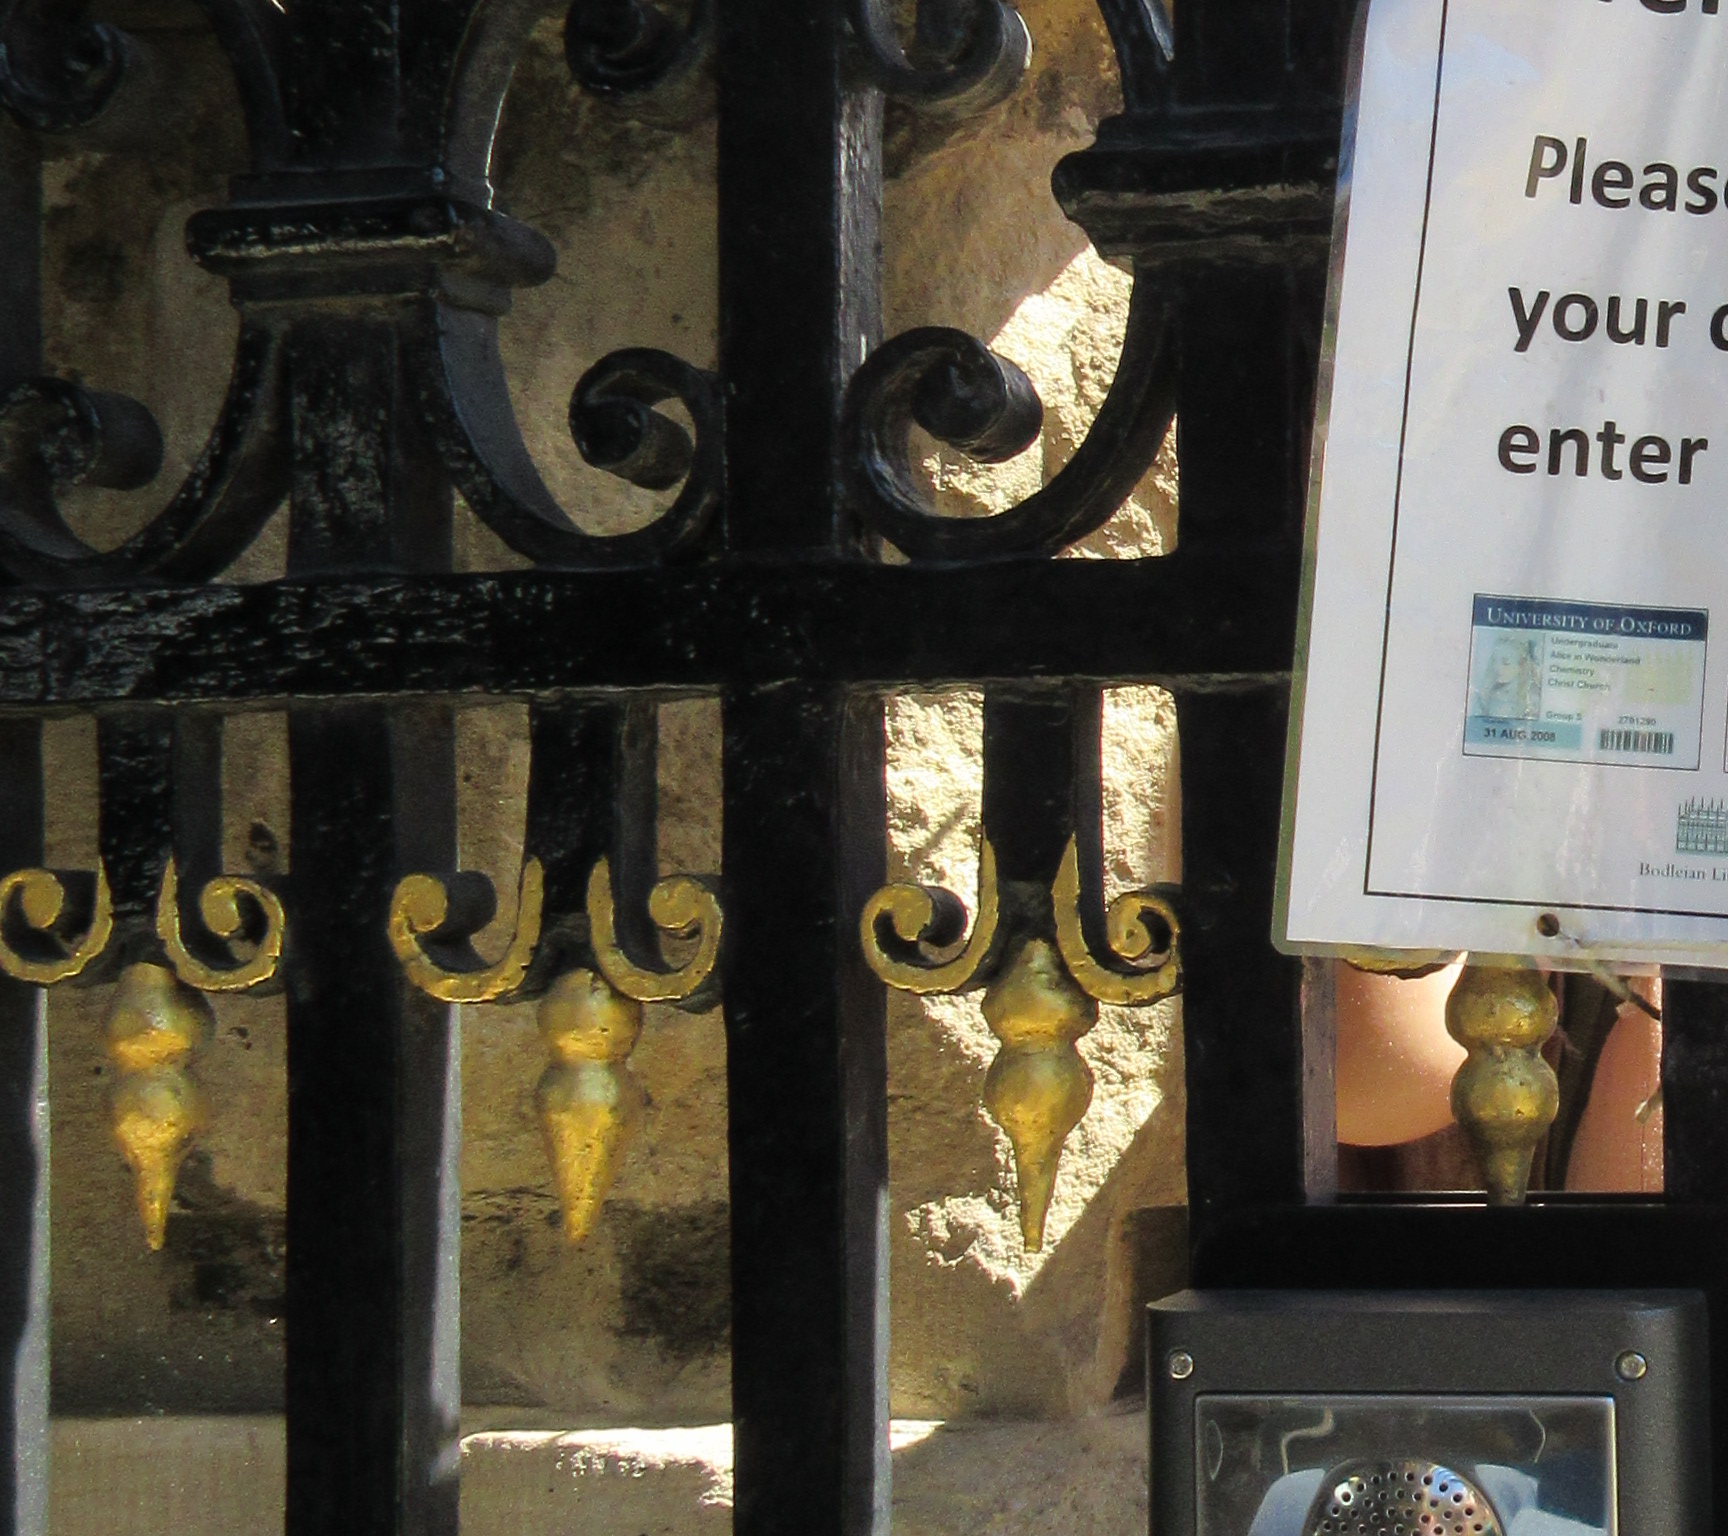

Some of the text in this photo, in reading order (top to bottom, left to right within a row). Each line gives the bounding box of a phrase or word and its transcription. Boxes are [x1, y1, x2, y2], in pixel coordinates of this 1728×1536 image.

[1508, 286, 1686, 354] your
[1497, 421, 1709, 485] enter
[1487, 607, 1692, 636] UNIVERSITY OF OXFORD
[1549, 664, 1595, 677] Chemistry
[1483, 727, 1497, 739] 31
[1500, 728, 1528, 741] AUG
[1639, 862, 1706, 880] Bodleian
